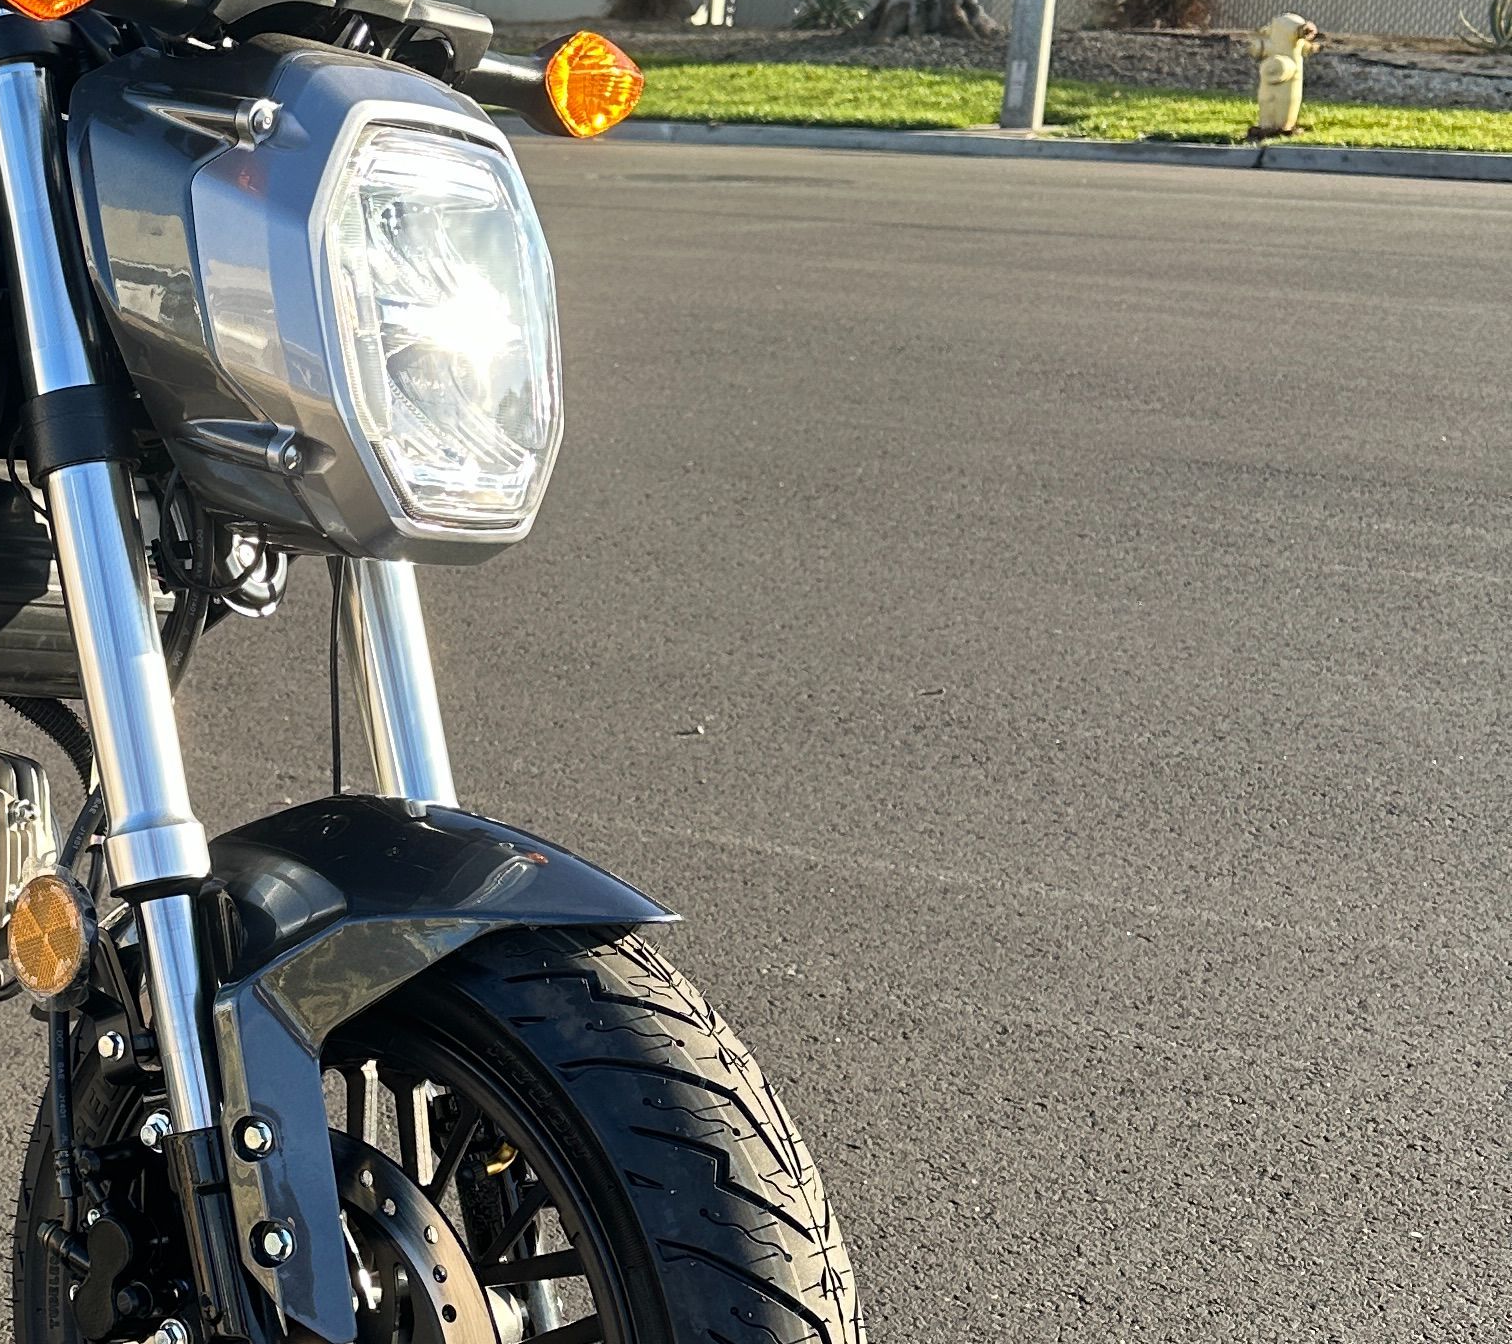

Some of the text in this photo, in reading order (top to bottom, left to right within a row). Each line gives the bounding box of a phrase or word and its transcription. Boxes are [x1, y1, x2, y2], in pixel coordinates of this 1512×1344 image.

[55, 1029, 64, 1049] DOT
[57, 1061, 65, 1079] SAE
[58, 1093, 67, 1119] J1401
